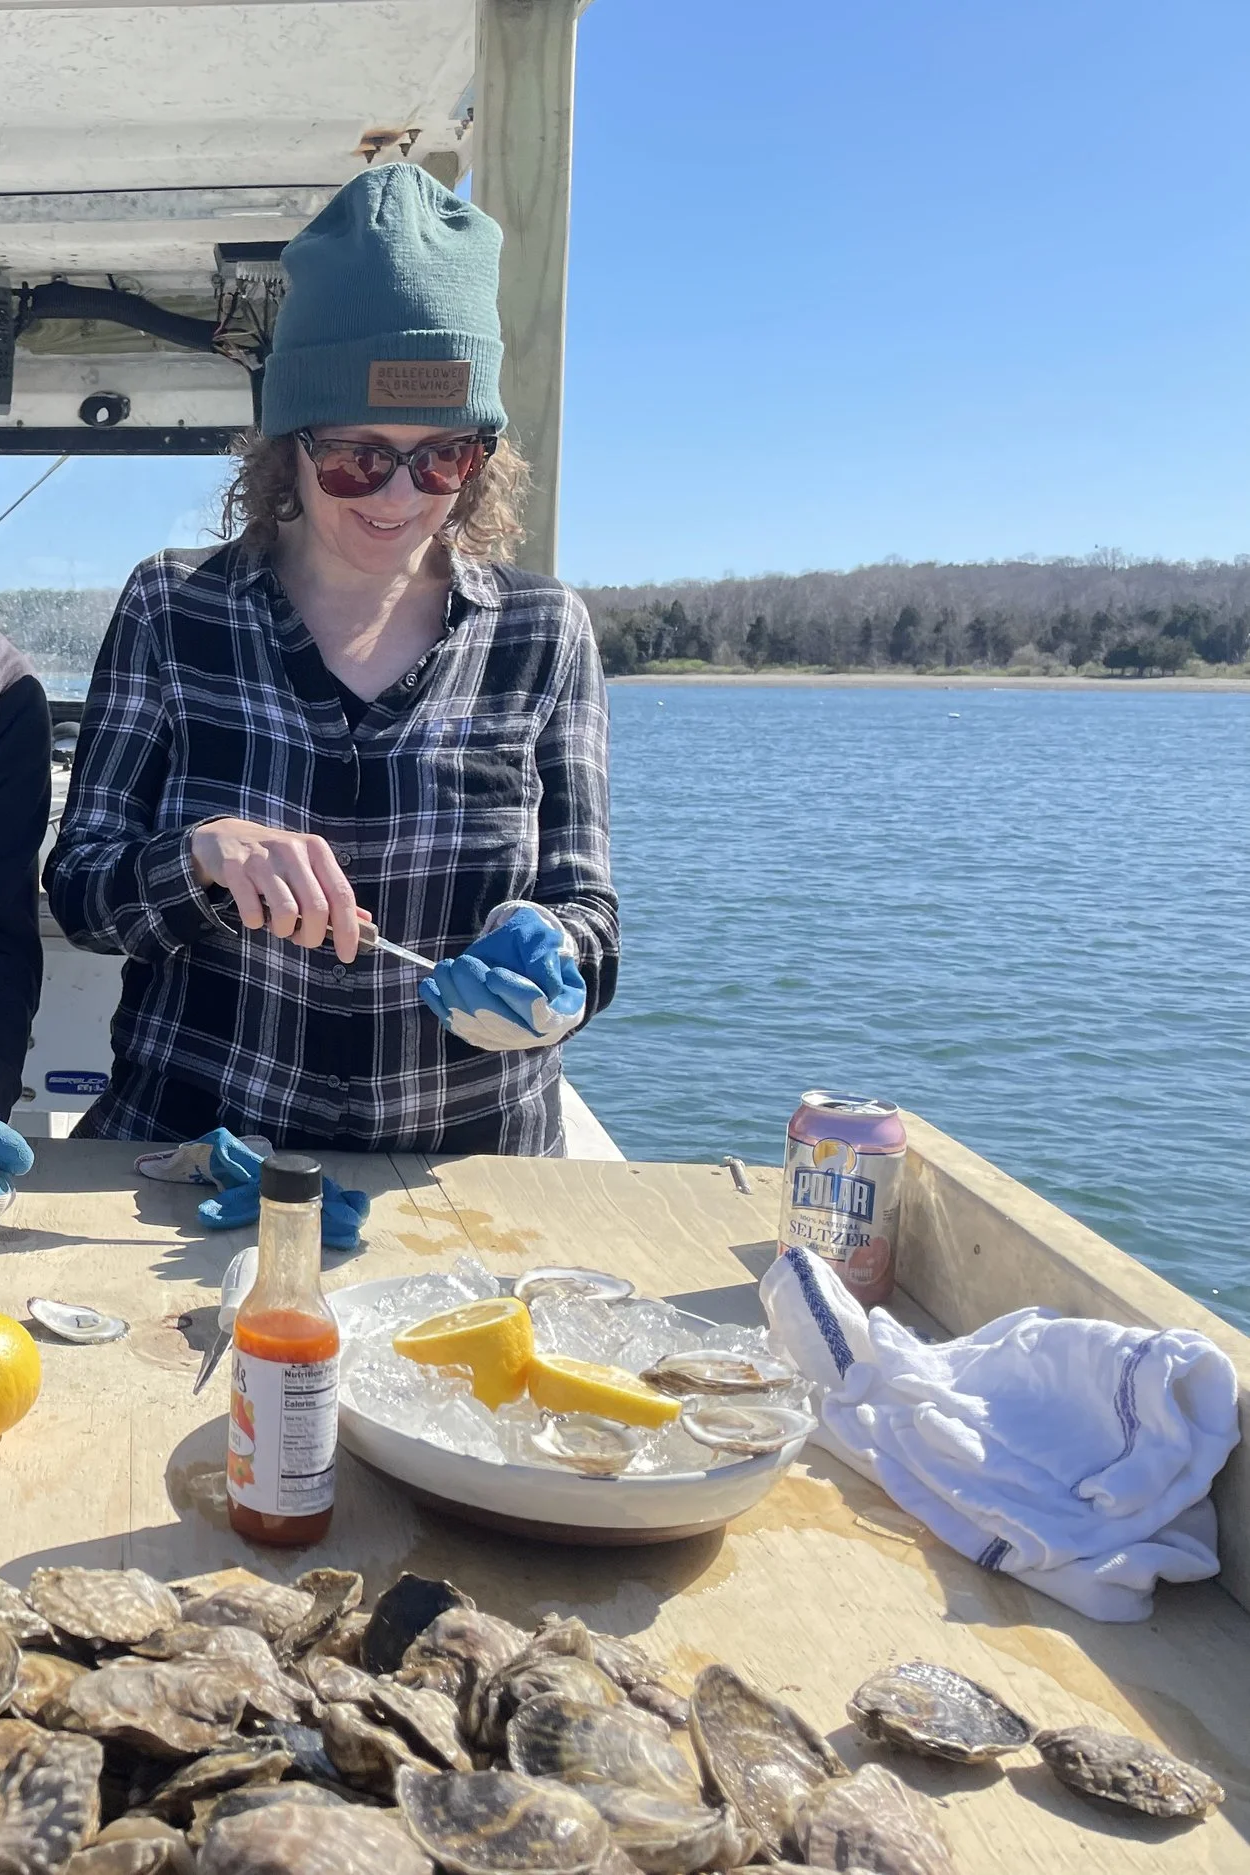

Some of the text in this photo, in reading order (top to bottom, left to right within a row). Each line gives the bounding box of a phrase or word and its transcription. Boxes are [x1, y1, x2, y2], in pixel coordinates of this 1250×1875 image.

[377, 367, 464, 378] BELLEFLOWER
[393, 380, 450, 391] BREWING
[796, 1172, 870, 1216] POLAR
[818, 1219, 860, 1230] NATURAL
[790, 1219, 870, 1247] SELTZER
[284, 1369, 324, 1378] Nutrition
[284, 1400, 317, 1408] Calories
